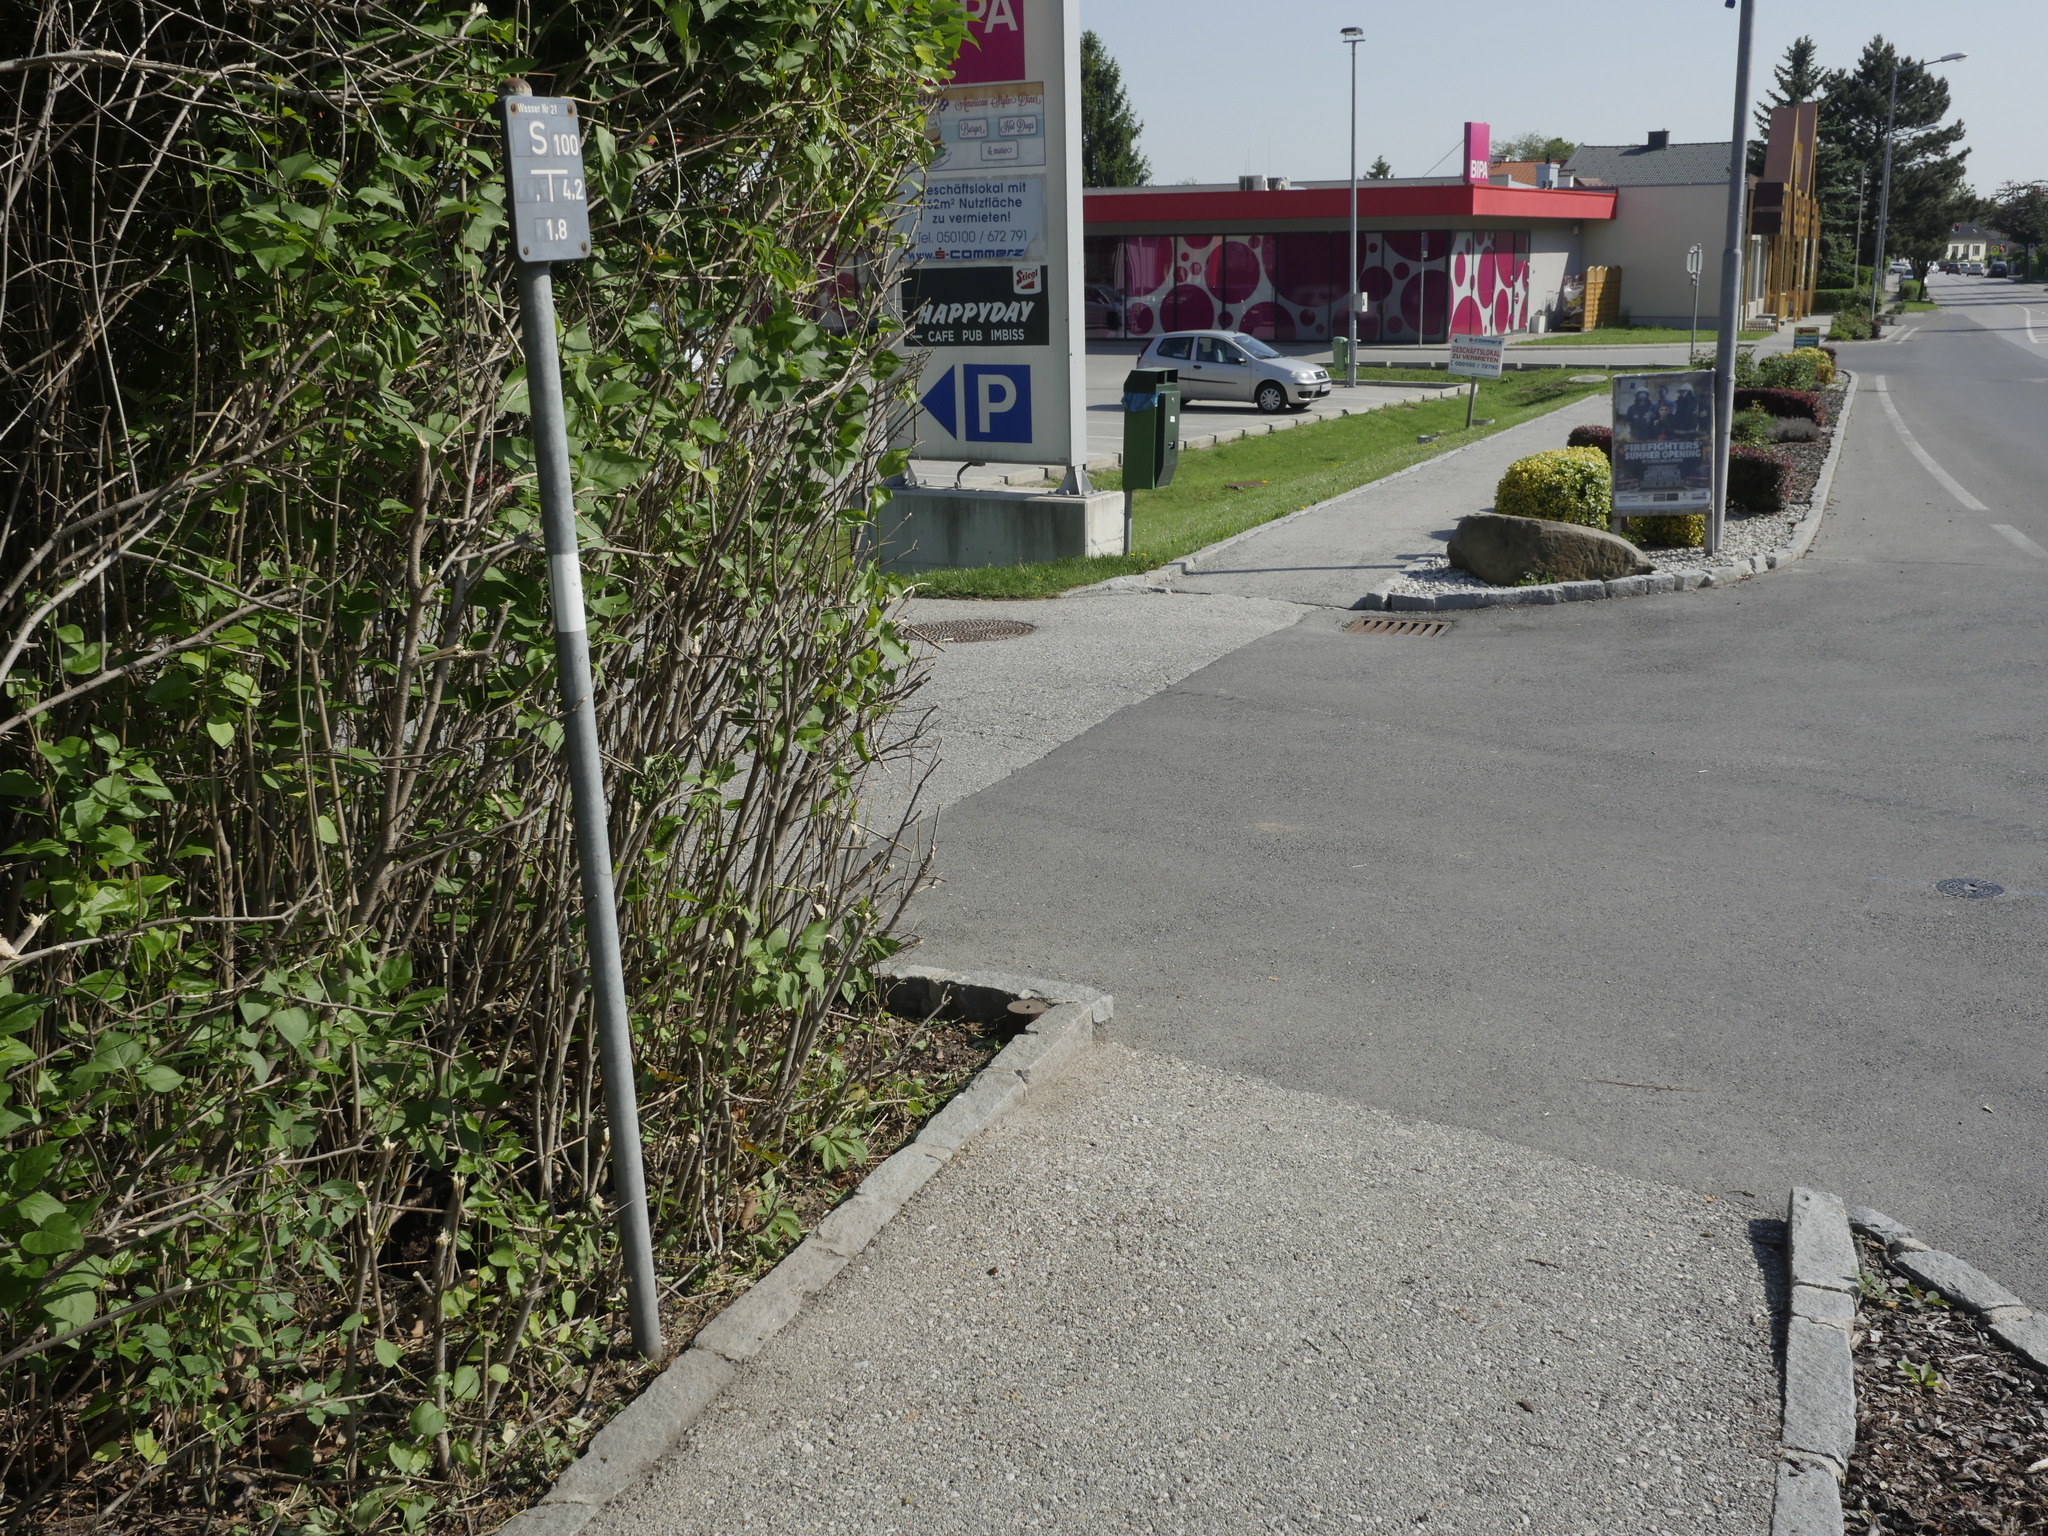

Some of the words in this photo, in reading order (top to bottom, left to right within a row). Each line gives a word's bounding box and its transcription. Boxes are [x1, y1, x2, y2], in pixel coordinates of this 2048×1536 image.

[517, 103, 541, 113] Wasser
[541, 104, 549, 113] Nr
[550, 105, 558, 115] 21
[961, 123, 985, 135] Burger
[1017, 119, 1035, 132] Dogs
[529, 121, 548, 155] S
[553, 134, 579, 156] 100
[1471, 160, 1488, 179] BIPA
[562, 178, 585, 201] 4,2
[1008, 182, 1026, 193] mit
[959, 198, 1022, 209] Nutzfläche
[932, 214, 945, 224] zu
[949, 211, 1011, 223] vermieten!
[546, 218, 568, 241] 1,8
[937, 231, 976, 243] 050100
[987, 230, 1007, 242] 672
[1010, 230, 1027, 242] 791
[1016, 268, 1038, 286] Stiegl
[917, 301, 1036, 326] HAPPYDAY
[928, 330, 955, 342] CAFE
[962, 329, 982, 341] PUB
[990, 329, 1025, 341] IMBISS
[1462, 354, 1499, 363] VERMIETEN
[977, 374, 1017, 433] P
[1624, 451, 1660, 460] SUMMER
[1662, 449, 1702, 458] OPENING
